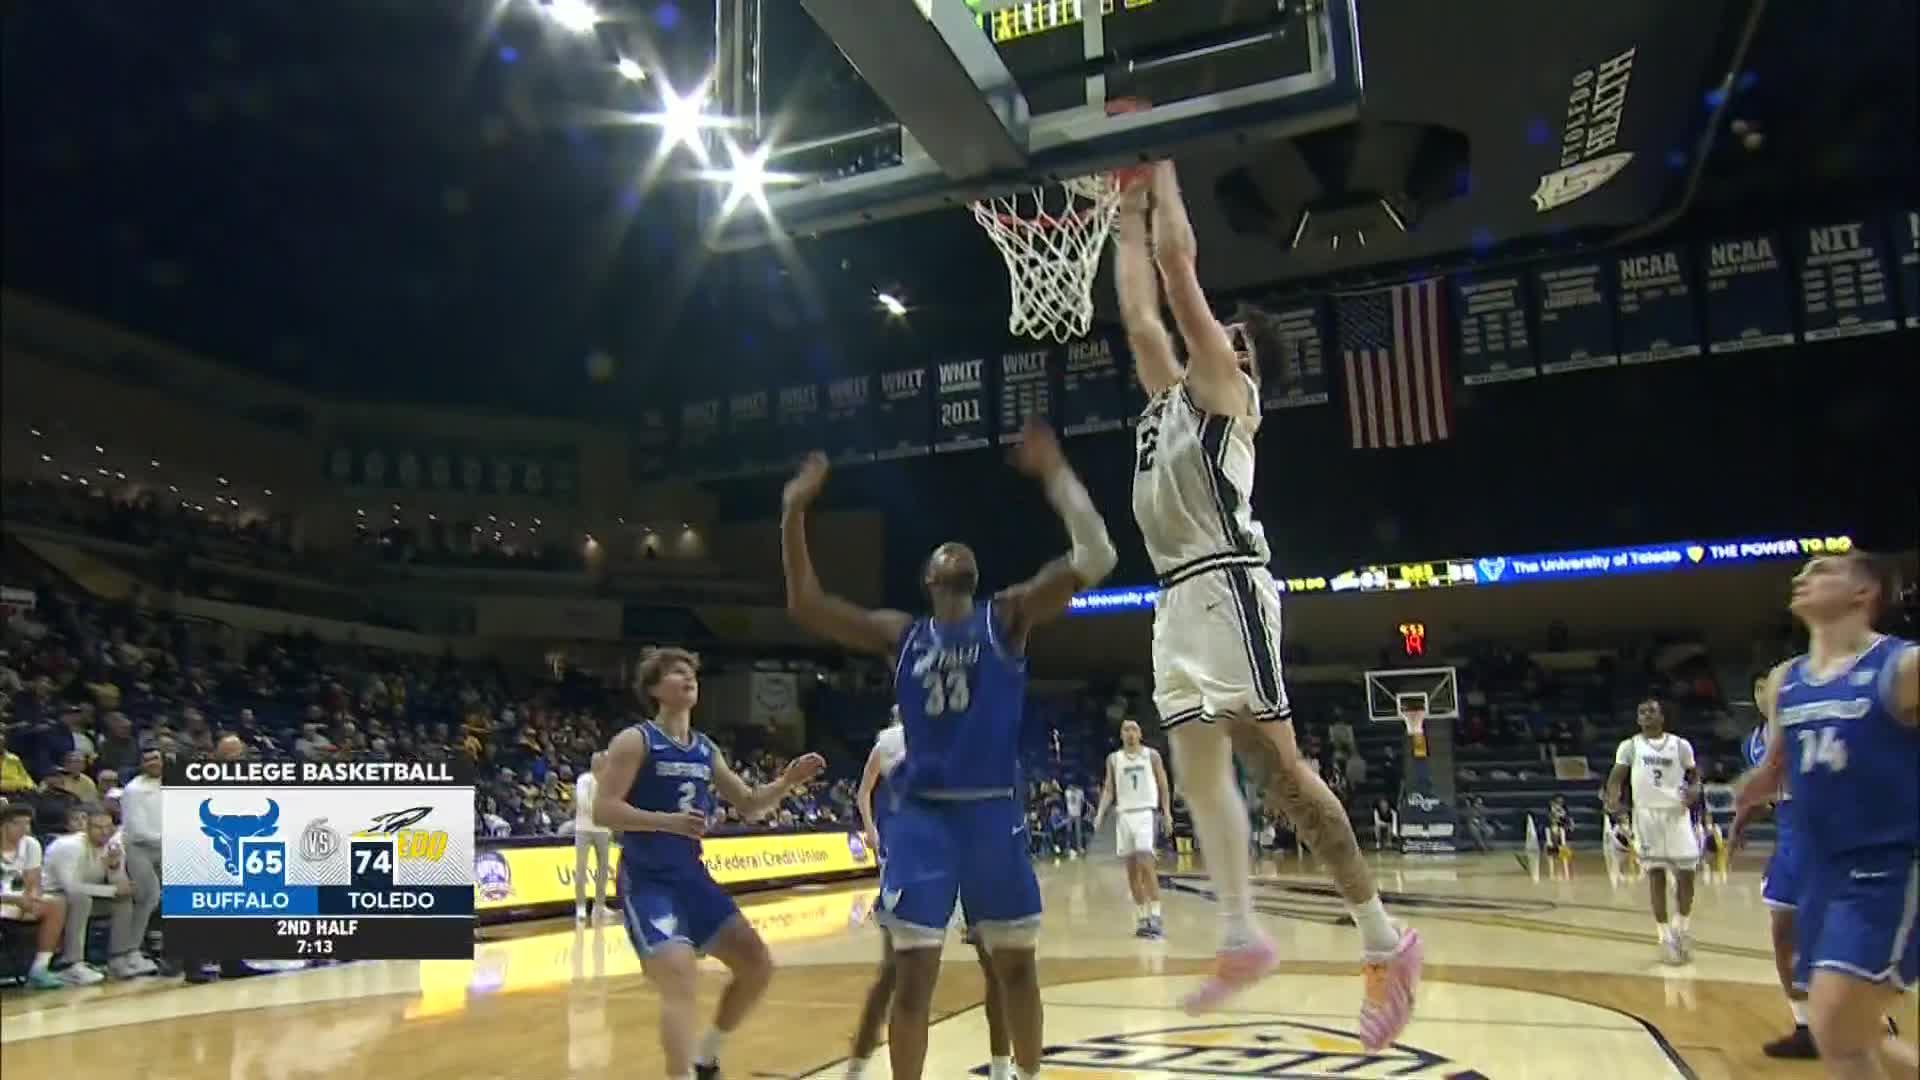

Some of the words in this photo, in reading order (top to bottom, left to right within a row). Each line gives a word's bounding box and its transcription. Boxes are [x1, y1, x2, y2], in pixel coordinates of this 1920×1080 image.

[1583, 46, 1637, 157] HEALTH
[1711, 237, 1772, 267] NCAA
[1809, 222, 1863, 255] NIT
[1619, 252, 1680, 280] NCAA
[938, 359, 984, 385] WNIT
[1003, 352, 1048, 374] WNIT
[941, 399, 981, 427] 2011
[1709, 544, 1739, 559] THE
[1740, 540, 1798, 557] POWER
[1799, 538, 1824, 552] TO
[1825, 535, 1852, 552] DO
[1512, 561, 1539, 574] The
[1541, 555, 1610, 571] University
[1612, 552, 1628, 566] of
[1629, 551, 1682, 565] Toledo
[1798, 726, 1849, 773] 14
[678, 781, 697, 809] 2
[763, 849, 798, 867] Credit
[799, 847, 829, 865] Union
